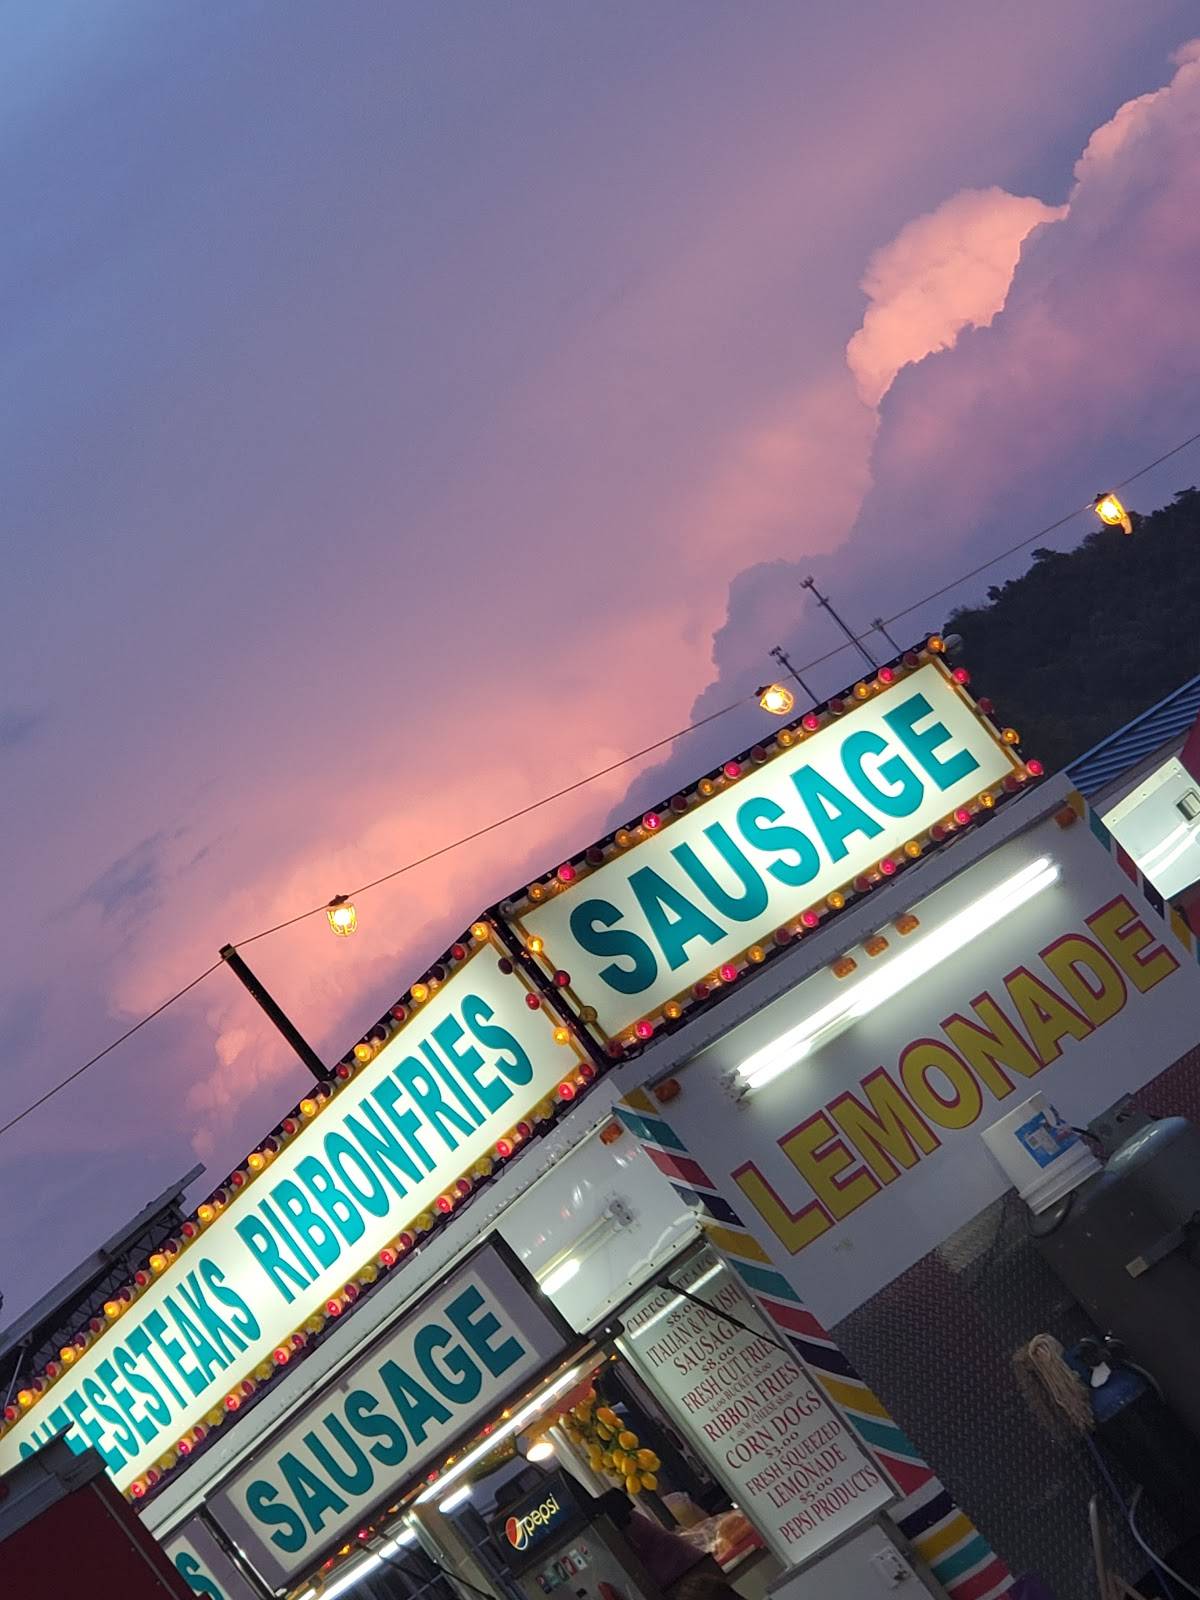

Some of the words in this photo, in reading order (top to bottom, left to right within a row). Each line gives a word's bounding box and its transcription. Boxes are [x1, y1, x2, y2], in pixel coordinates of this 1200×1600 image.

[569, 692, 980, 994] SAUSAGE
[730, 894, 1181, 1255] LEMONADE
[671, 1253, 720, 1295] TEAKS
[19, 1258, 261, 1475] EESESTEAKS
[646, 1321, 694, 1367] ITALIAN
[688, 1316, 702, 1334] &
[702, 1346, 734, 1374] $8.00
[681, 1375, 723, 1414] FRESH
[717, 1356, 745, 1385] CUT
[703, 1391, 761, 1442] RIBBON
[755, 1360, 800, 1401] FRIES
[723, 1374, 753, 1400] BUCKET
[244, 1284, 526, 1553] SAUSAGE
[726, 1426, 775, 1469] CORN
[771, 1390, 821, 1436] DOGS
[766, 1432, 799, 1458] $3.00
[746, 1463, 784, 1496] FRESH
[781, 1420, 841, 1470] SQUEEZED
[767, 1443, 847, 1508] LEMONADE
[800, 1477, 833, 1504] $5.00
[521, 1492, 561, 1537] pepsi
[778, 1510, 817, 1544] PEPSI
[811, 1465, 879, 1522] PRODUCTS
